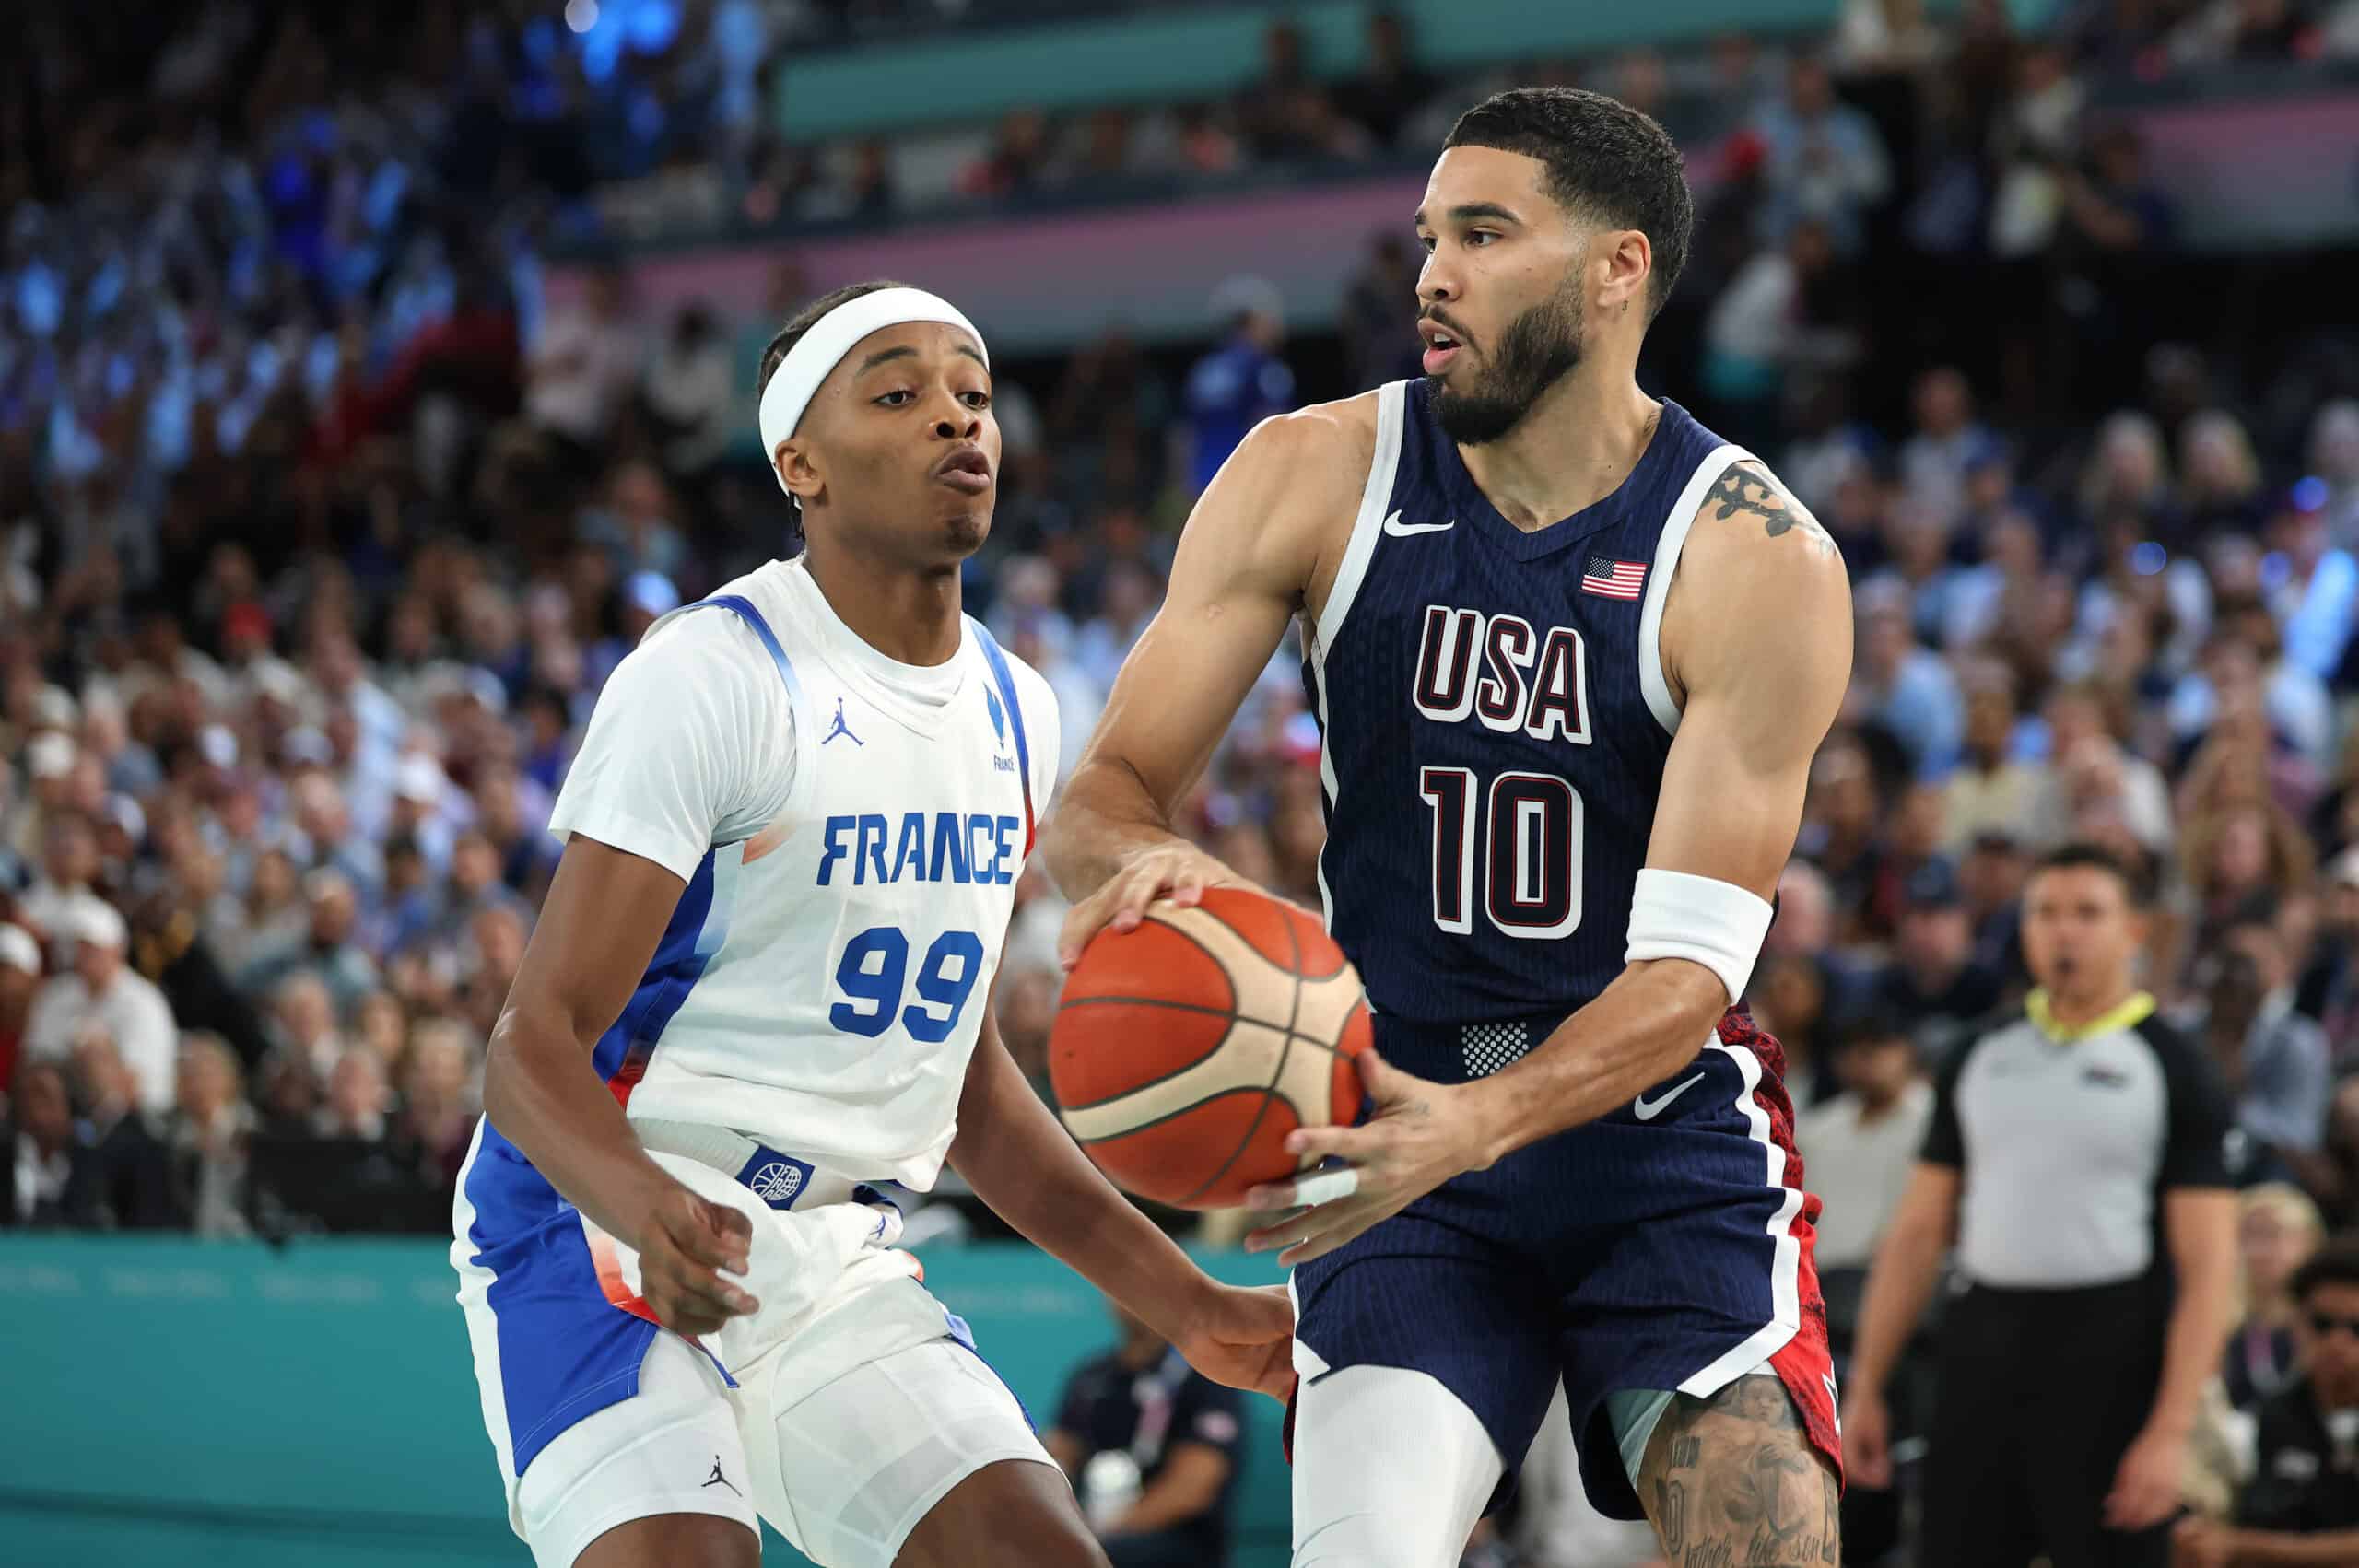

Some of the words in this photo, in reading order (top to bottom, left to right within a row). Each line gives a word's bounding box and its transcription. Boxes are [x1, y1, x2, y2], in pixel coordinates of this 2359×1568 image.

[1413, 604, 1592, 745] USA
[993, 754, 1015, 772] FRANCE
[816, 812, 1019, 886] FRANCE
[1420, 766, 1584, 940] 10
[829, 927, 984, 1043] 99
